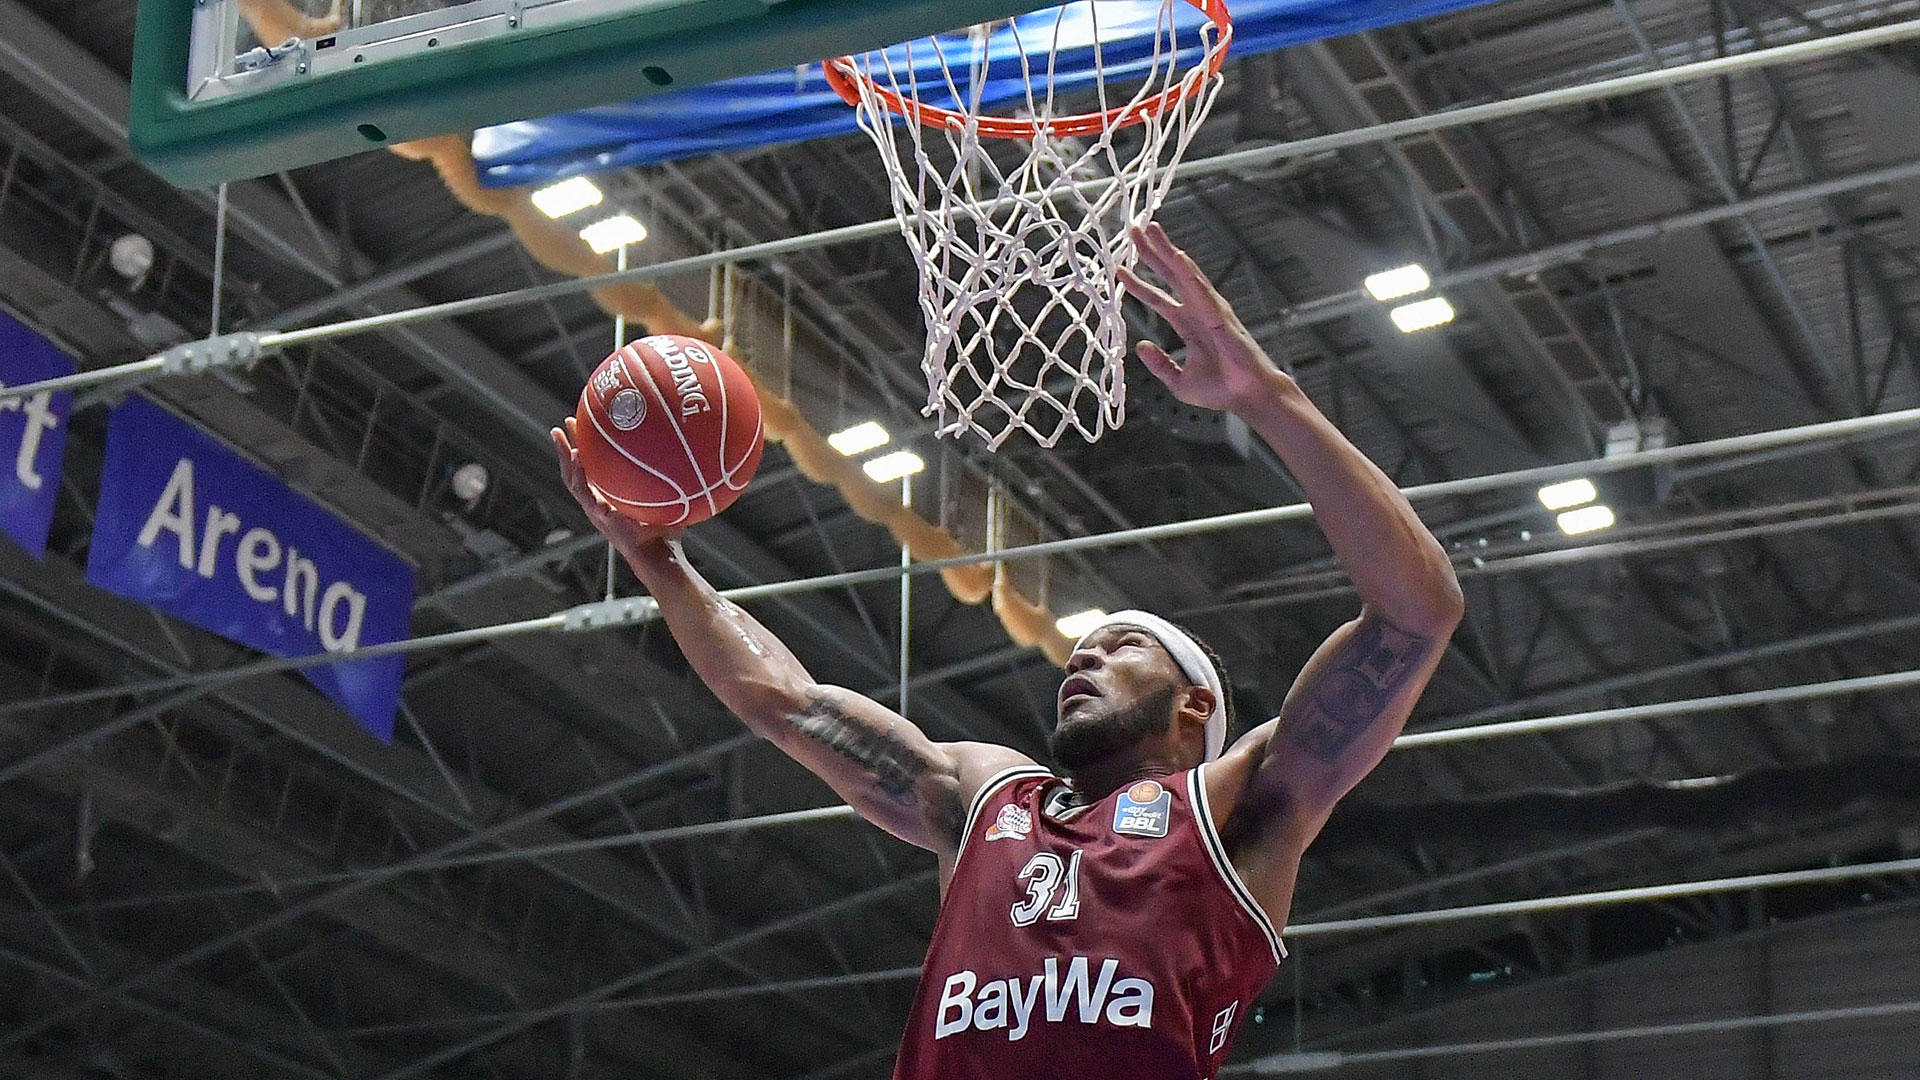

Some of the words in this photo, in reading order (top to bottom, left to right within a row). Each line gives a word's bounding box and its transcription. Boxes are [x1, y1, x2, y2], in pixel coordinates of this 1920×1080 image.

[637, 334, 711, 417] PALDING
[0, 383, 57, 489] t
[137, 457, 367, 654] Arena
[1119, 816, 1160, 831] BBL
[1010, 849, 1084, 927] 31
[935, 956, 1154, 1041] BayWa
